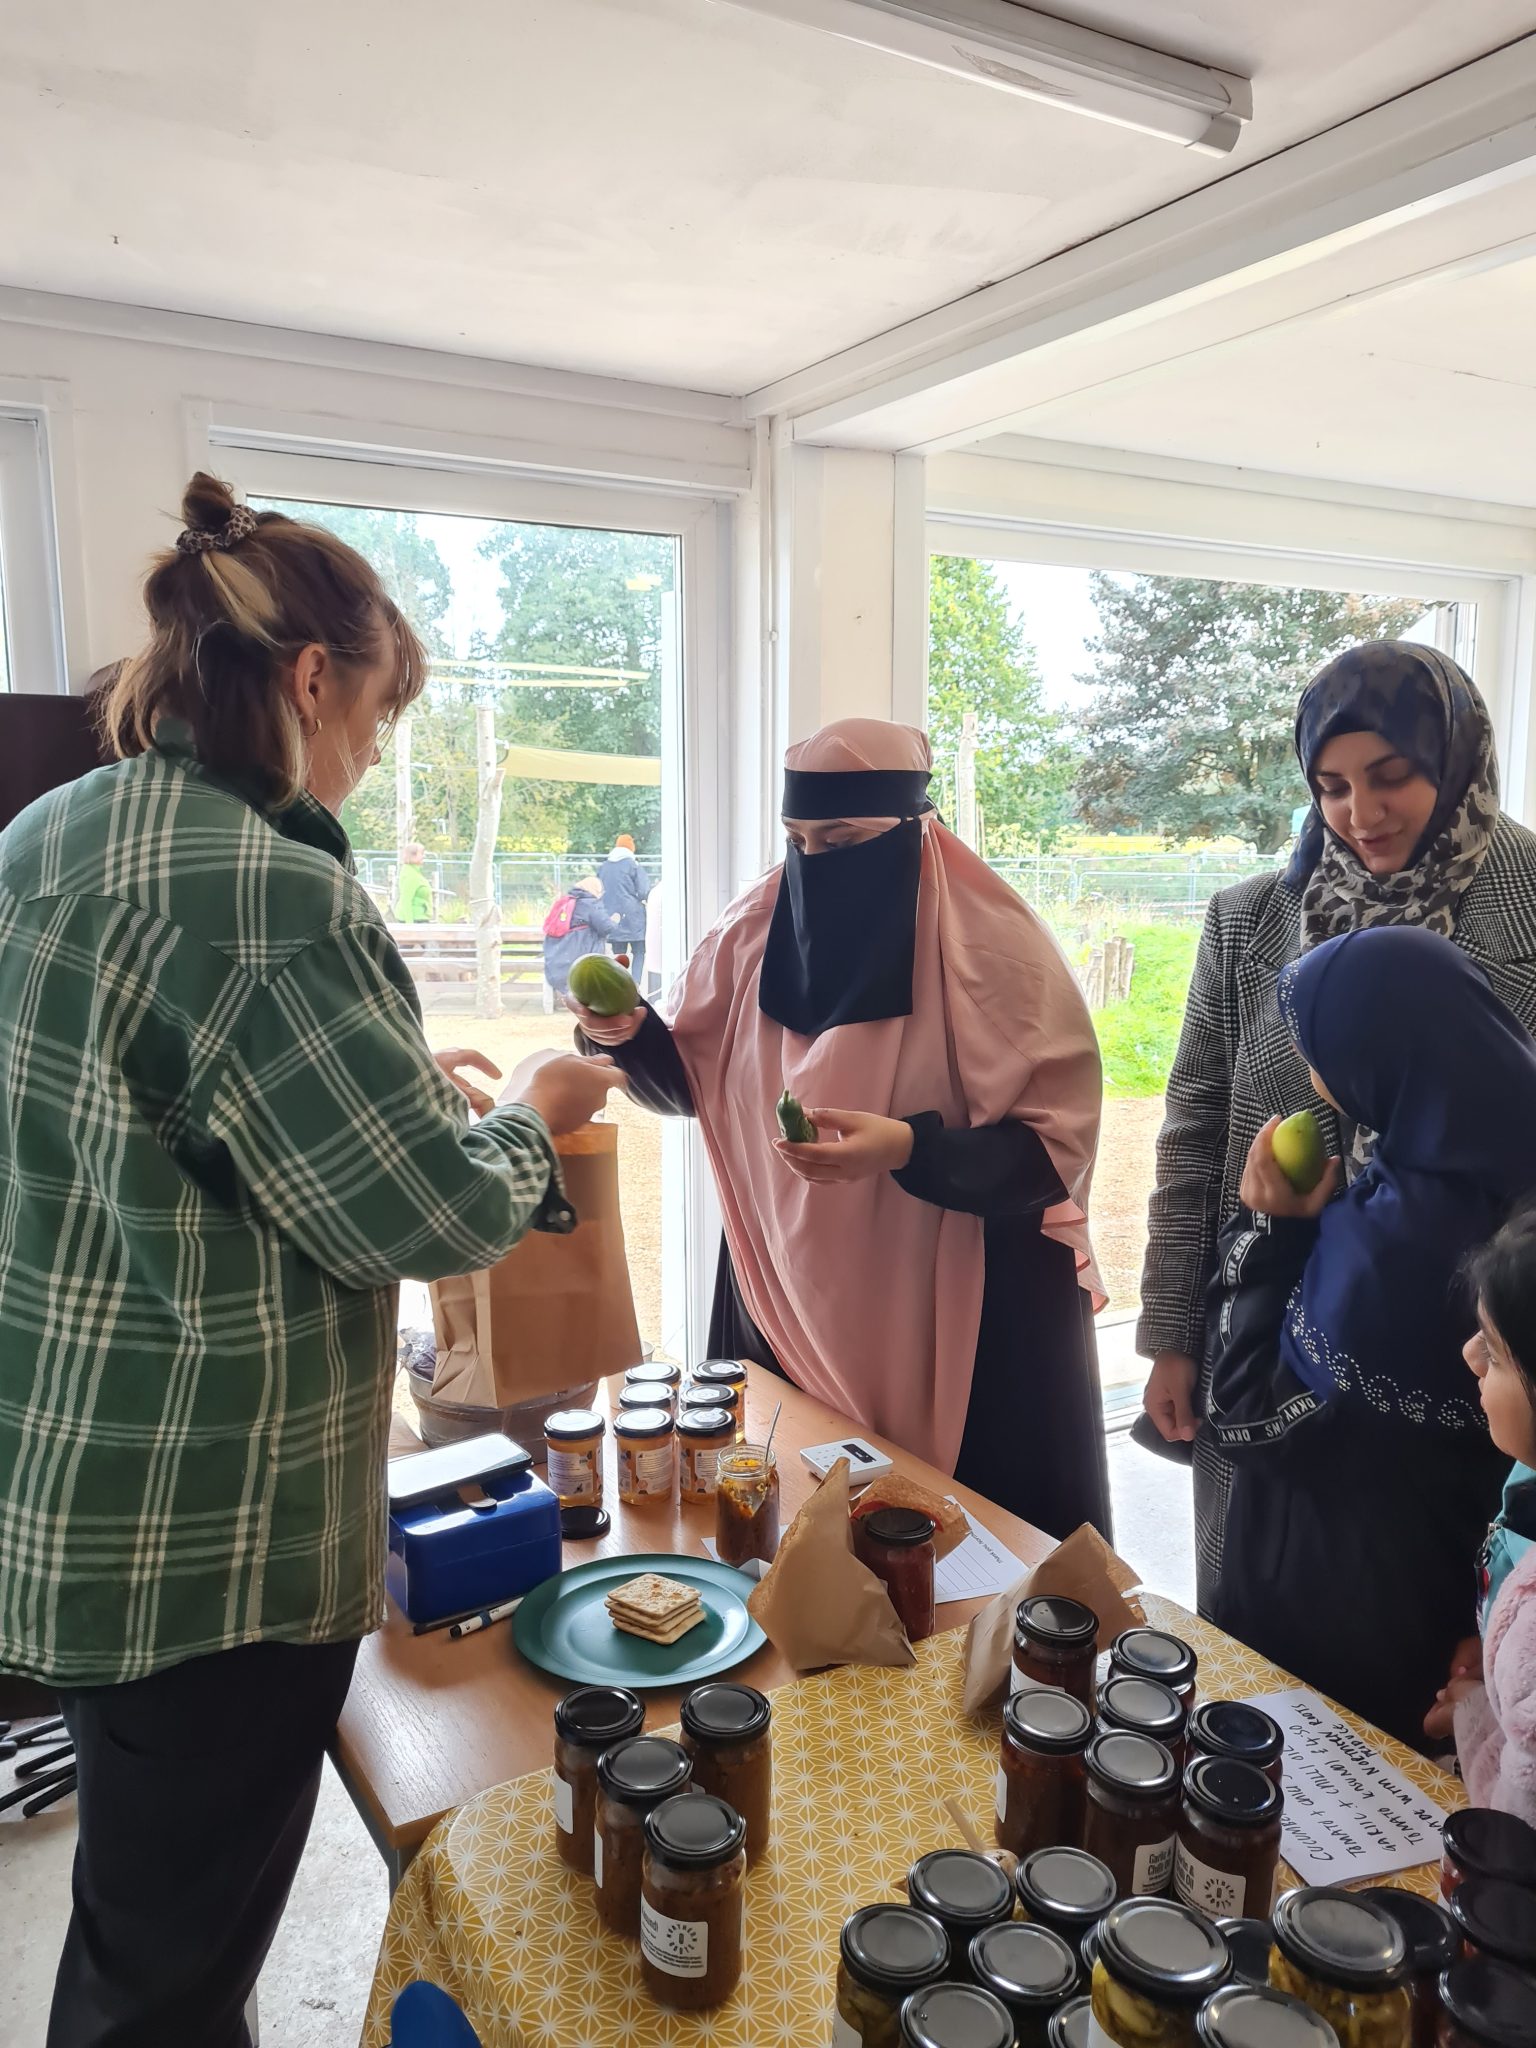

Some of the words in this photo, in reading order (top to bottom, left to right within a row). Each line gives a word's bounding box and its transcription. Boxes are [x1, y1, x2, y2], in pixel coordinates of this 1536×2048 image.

[1283, 1396, 1317, 1423] DKNY
[1221, 1428, 1252, 1442] DKNY
[1317, 1820, 1367, 1858] TOMATO
[1377, 1807, 1424, 1846] TOMATO
